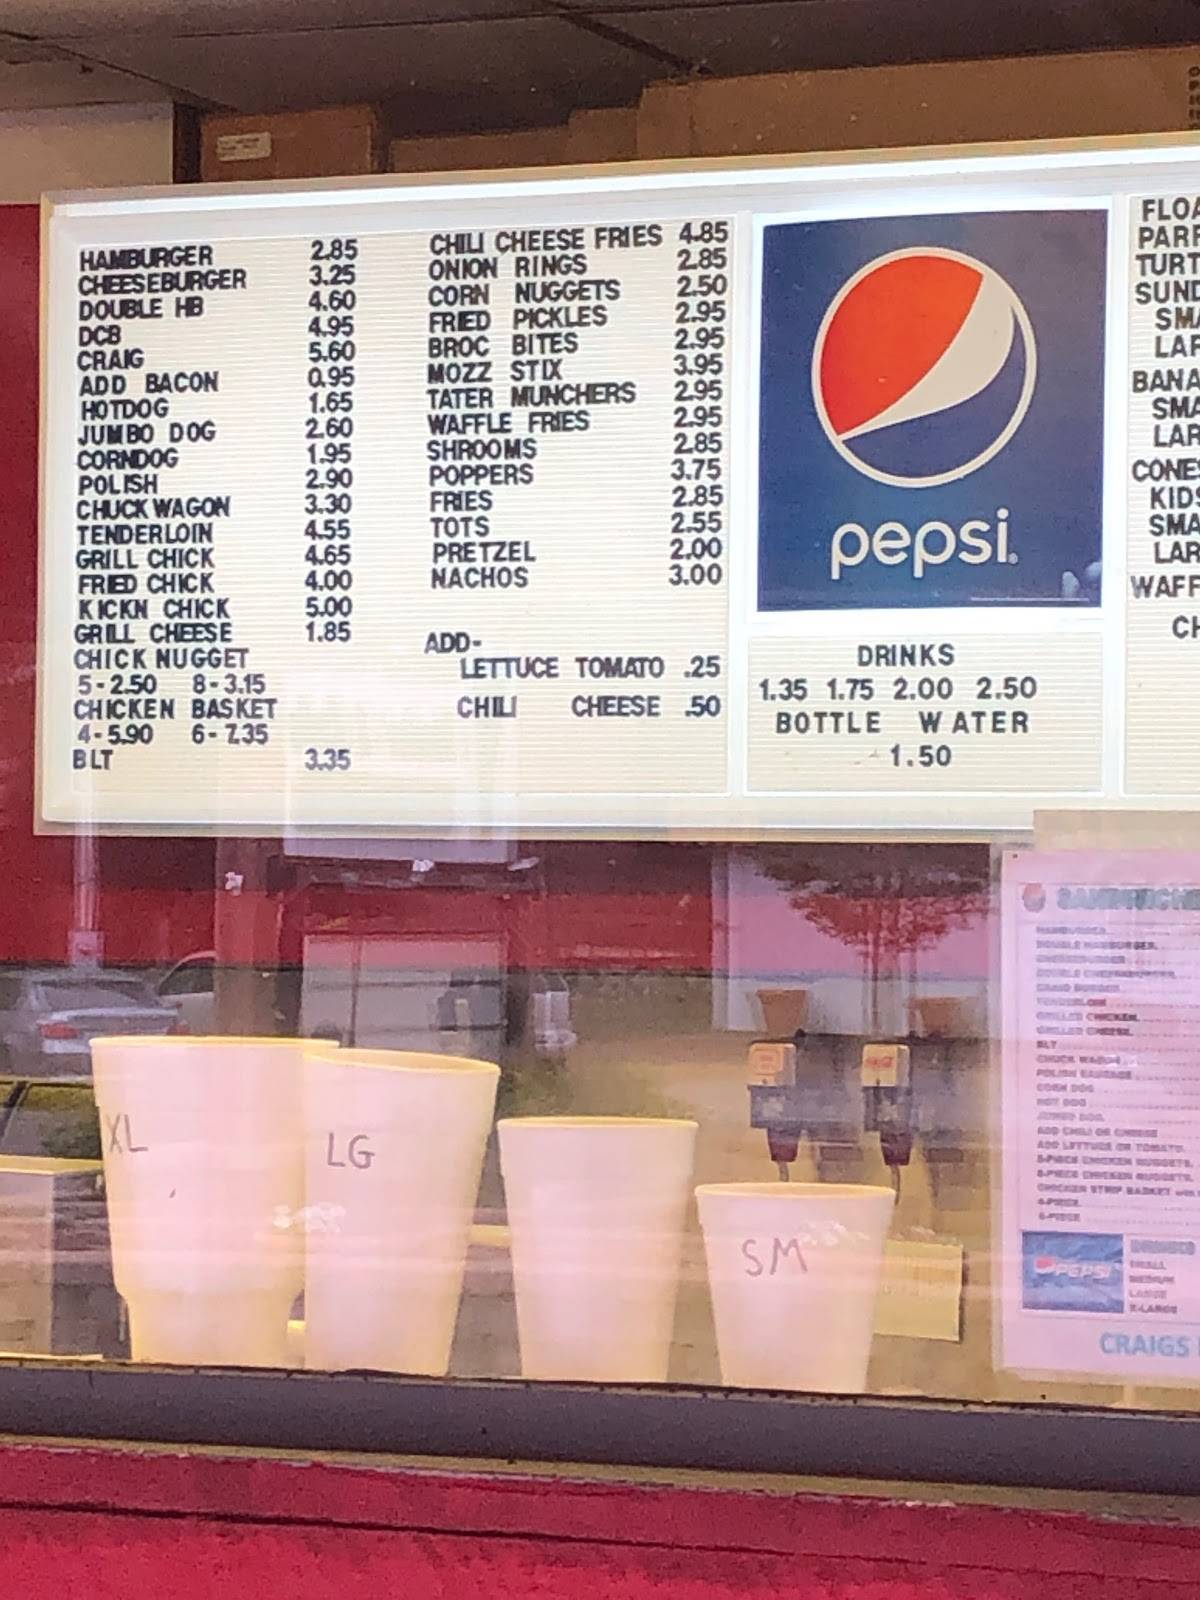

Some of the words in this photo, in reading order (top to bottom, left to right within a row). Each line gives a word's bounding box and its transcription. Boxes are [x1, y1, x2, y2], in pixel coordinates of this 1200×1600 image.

[429, 232, 484, 256] CHILI
[494, 228, 584, 254] CHEESE
[595, 224, 663, 249] FRIES
[679, 220, 728, 244] 4.85
[80, 245, 213, 271] HAMBURGER
[311, 239, 358, 260] 2.85
[429, 256, 498, 281] ONION
[515, 253, 587, 278] RINGS
[677, 248, 728, 271] 2.85
[78, 269, 247, 296] CHEESEBURGER
[309, 264, 356, 286] 3.25
[428, 284, 490, 307] CORN
[515, 279, 620, 303] NUGGETS
[677, 274, 728, 298] 2.50
[79, 299, 163, 321] DOUBLE
[175, 296, 204, 317] HB
[308, 290, 356, 311] 4.60
[429, 310, 491, 333] FRIED
[513, 305, 608, 330] PICKLES
[675, 300, 726, 324] 2.95
[79, 325, 122, 347] DCB
[308, 315, 354, 337] 4.95
[429, 336, 490, 358] BROC
[512, 332, 578, 356] BITES
[674, 327, 725, 350] 2.95
[77, 348, 144, 371] CRAIG
[308, 341, 356, 362] 5.60
[427, 361, 492, 384] MOZZ
[510, 359, 563, 382] STIX
[674, 353, 723, 375] 3.95
[80, 375, 126, 397] ADD
[145, 371, 219, 394] BACON
[307, 367, 354, 388] 0.95
[426, 387, 493, 410] TATER
[510, 382, 636, 408] MUNCHERS
[674, 379, 723, 402] 2.95
[1133, 368, 1200, 393] BANA
[81, 398, 169, 421] HOTDOG
[308, 391, 353, 413] 1.65
[78, 424, 154, 446] JUMBO
[169, 420, 216, 442] DOG
[305, 417, 353, 439] 2.60
[428, 412, 512, 436] WAFFLE
[528, 410, 590, 433] FRIES
[674, 406, 723, 428] 2.95
[77, 448, 179, 471] CORNDOG
[307, 443, 352, 464] 1.95
[427, 438, 537, 462] SHROOMS
[673, 432, 723, 454] 2.85
[78, 474, 158, 496] POLISH
[305, 468, 353, 489] 2.90
[429, 463, 534, 486] POPPERS
[671, 458, 721, 481] 3.75
[77, 500, 148, 520] CHUCK
[152, 496, 231, 518] WAGON
[304, 494, 352, 515] 3.30
[429, 490, 493, 513] FRIES
[672, 485, 723, 507] 2.85
[77, 522, 213, 546] TENDERLOIN
[304, 519, 351, 540] 4.55
[430, 516, 490, 538] TOTS
[671, 511, 722, 534] 2.55
[76, 548, 138, 570] GRILL
[147, 547, 215, 569] CHICK
[305, 544, 351, 566] 4.65
[433, 541, 537, 563] PRETZEL
[670, 538, 723, 561] 2.00
[831, 508, 1008, 580] pepsi
[78, 574, 137, 594] FRIED
[147, 573, 215, 594] CHICK
[304, 569, 353, 591] 4.00
[430, 566, 529, 589] NACHOS
[669, 563, 723, 586] 3.00
[78, 598, 148, 620] KICKN
[163, 597, 230, 619] CHICK
[305, 596, 353, 618] 5.00
[74, 624, 135, 645] GRILL
[150, 623, 232, 643] CHEESE
[305, 621, 351, 643] 1.85
[74, 648, 146, 670] CHICK
[156, 648, 249, 669] NUGGET
[460, 657, 559, 679] LETTUCE
[575, 657, 665, 679] TOMATO
[683, 655, 721, 678] .25
[857, 644, 955, 668] DRINKS
[759, 678, 807, 701] 1.35
[827, 678, 873, 701] 1.75
[893, 677, 953, 700] 2.00
[976, 677, 1037, 700] 2.50
[74, 699, 175, 720] CHICKEN
[191, 699, 277, 719] BASKET
[457, 696, 517, 719] CHILI
[571, 696, 660, 718] CHEESE
[685, 695, 721, 717] .50
[775, 711, 881, 734] BOTTLE
[919, 711, 1029, 734] WATER
[73, 749, 113, 770] BLT
[305, 748, 351, 770] 3.35
[891, 744, 951, 767] 1.50
[107, 1114, 149, 1153] XL
[327, 1132, 375, 1169] LG
[741, 1236, 808, 1278] SM
[1100, 1331, 1190, 1357] CRAIGS
